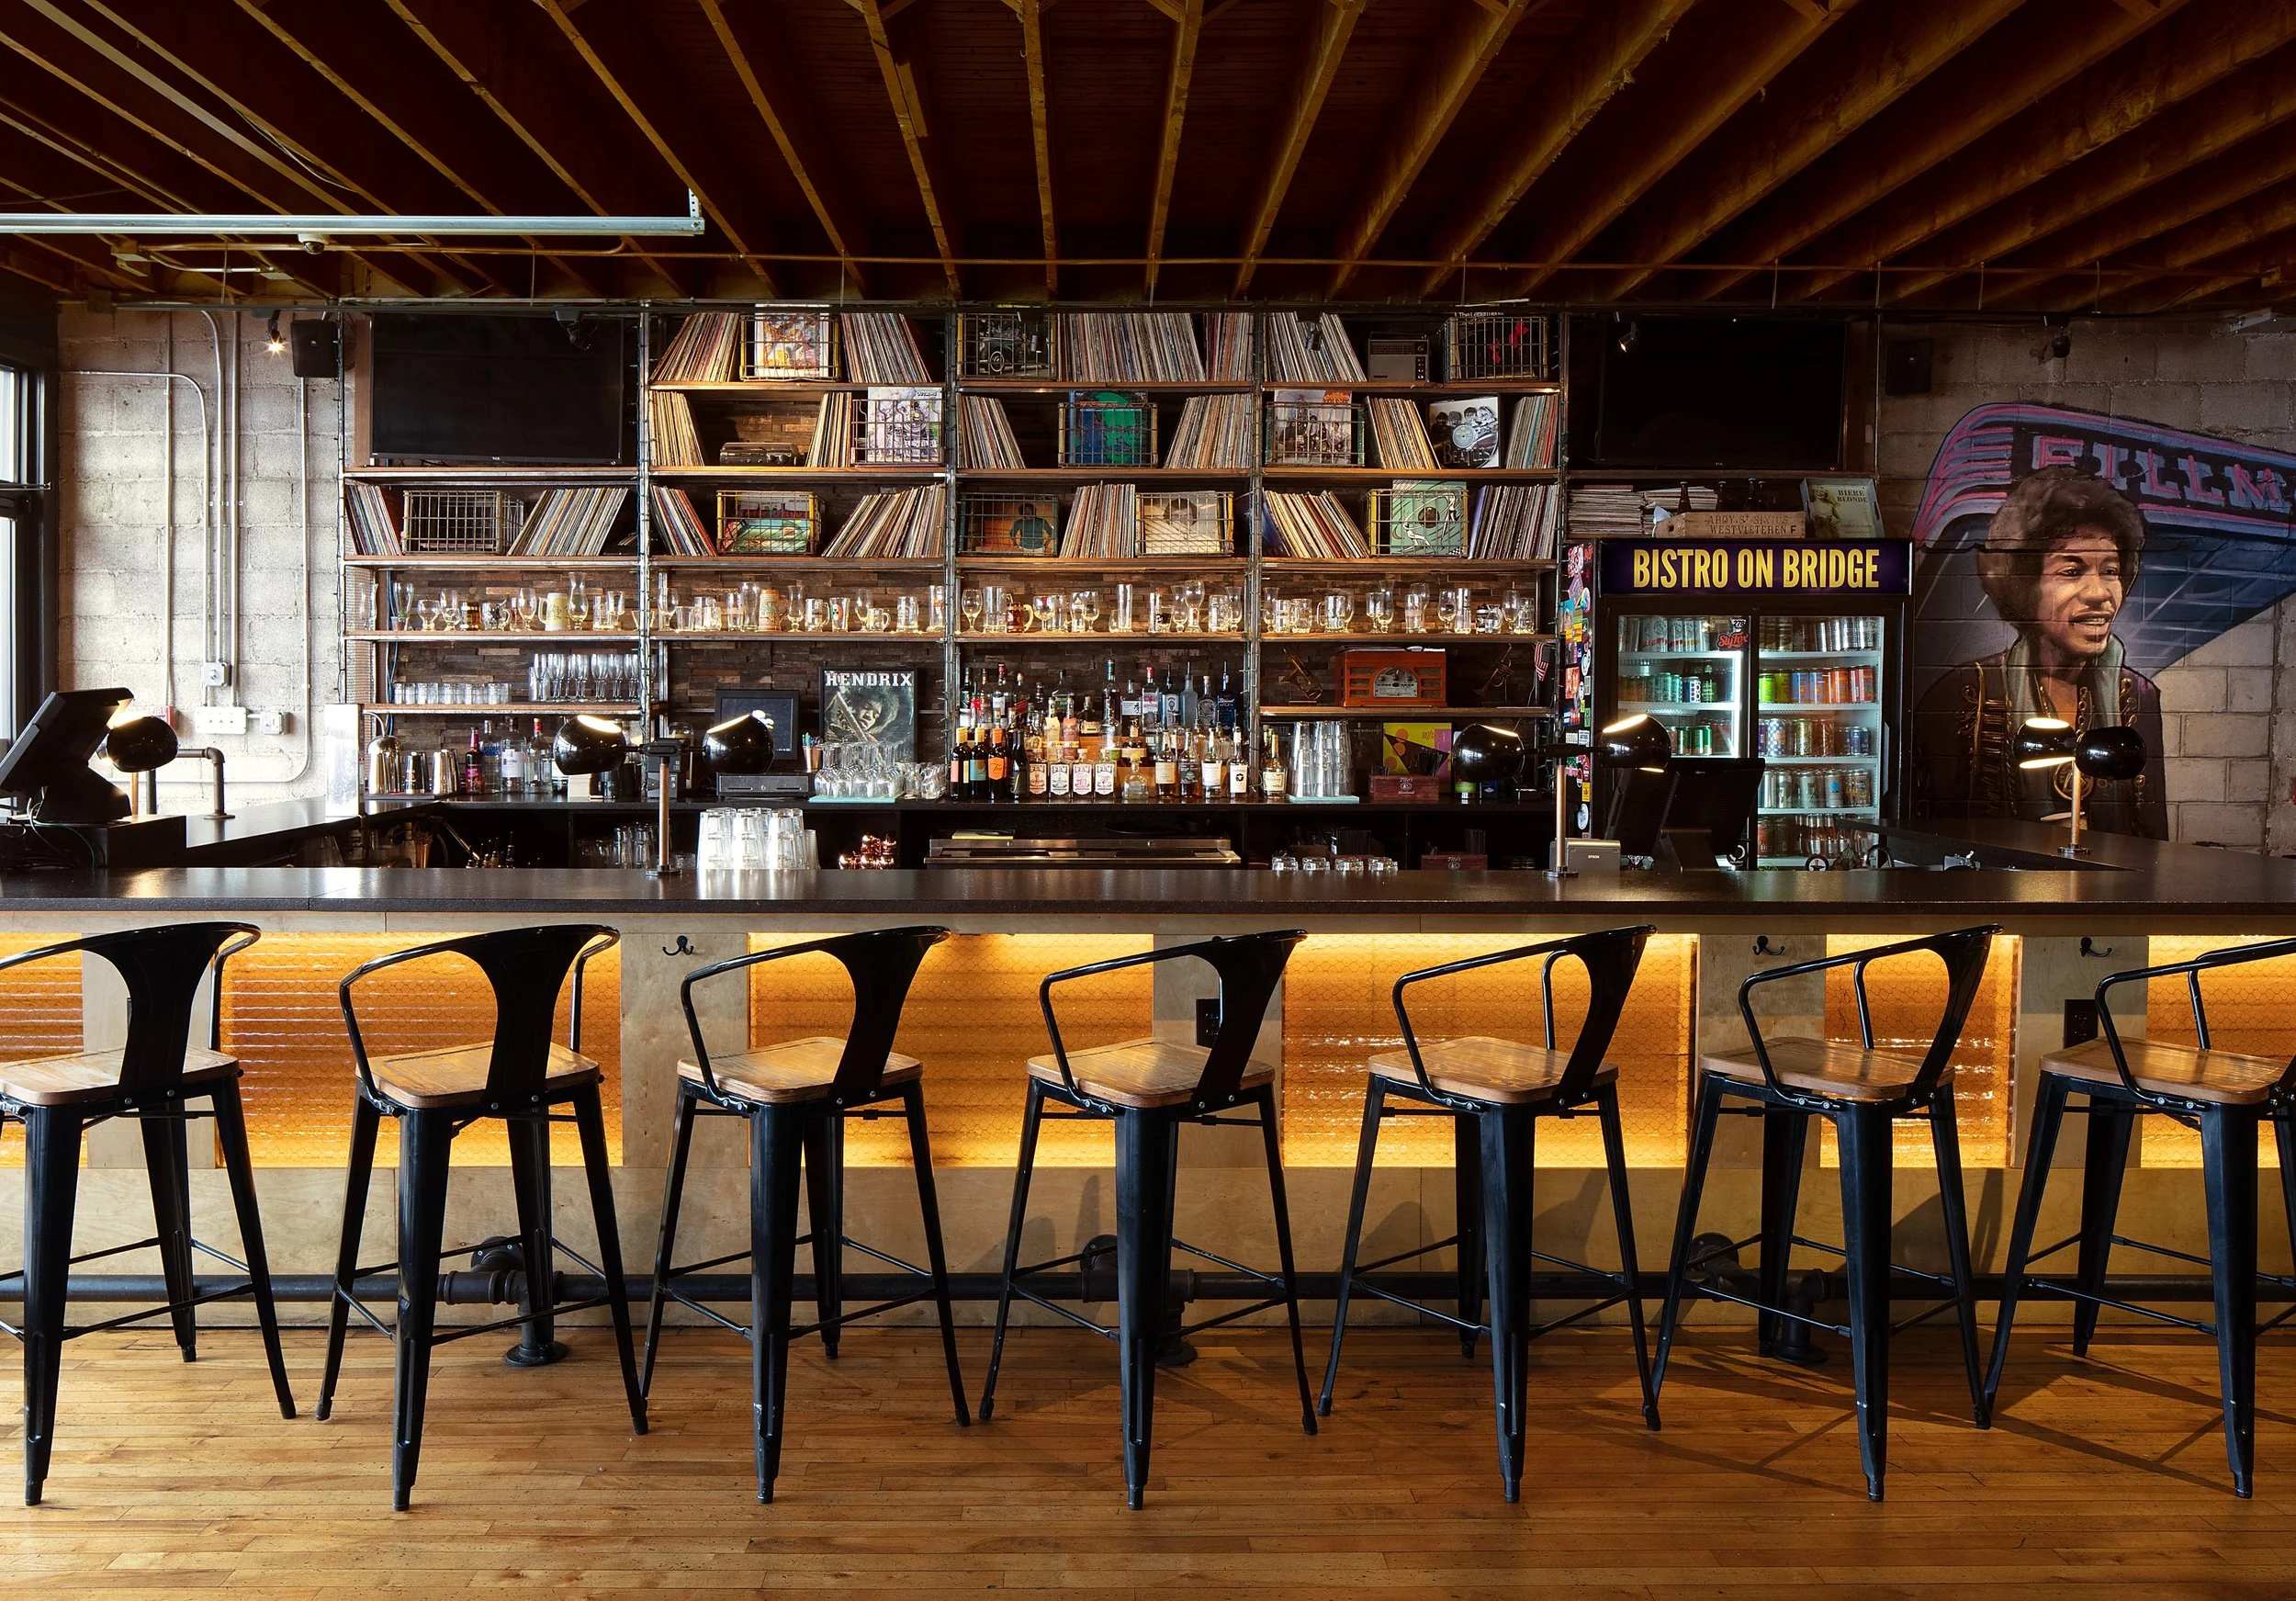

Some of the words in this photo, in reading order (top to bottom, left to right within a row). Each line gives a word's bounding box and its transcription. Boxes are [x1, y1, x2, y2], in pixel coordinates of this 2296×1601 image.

[2032, 435, 2296, 514] FILLM
[1710, 524, 1787, 535] WESTVLETEREN
[1790, 524, 1797, 535] F
[1633, 548, 1728, 588] BISTRO
[1737, 548, 1773, 588] ON
[1783, 548, 1880, 588] BRIDGE
[825, 672, 913, 687] HENDRIX
